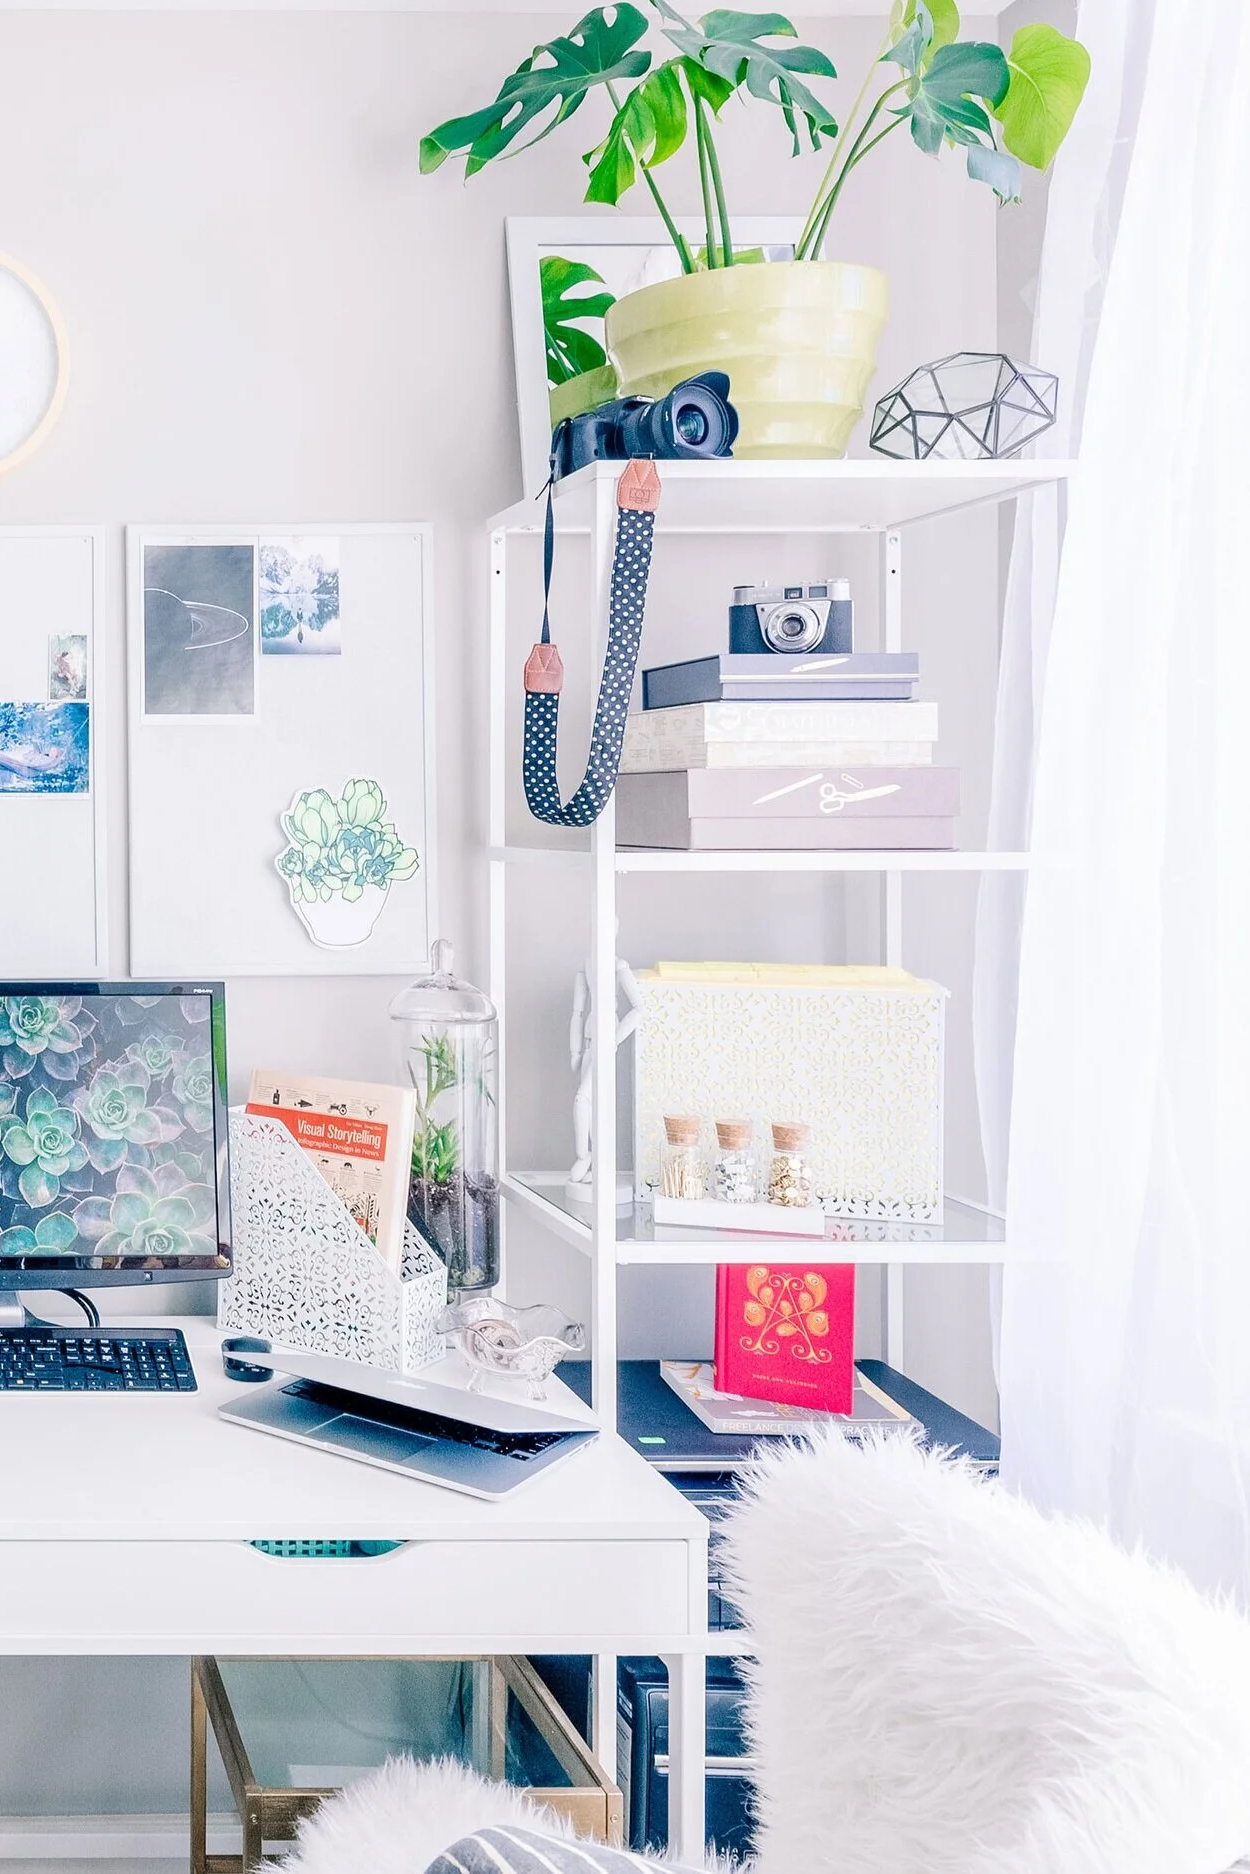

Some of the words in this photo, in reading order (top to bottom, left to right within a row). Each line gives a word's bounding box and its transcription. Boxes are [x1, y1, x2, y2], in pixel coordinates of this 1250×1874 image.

[297, 1119, 326, 1138] Visual
[327, 1123, 382, 1150] Storytelling
[332, 1143, 354, 1154] Design
[722, 1422, 784, 1433] FREELANCE
